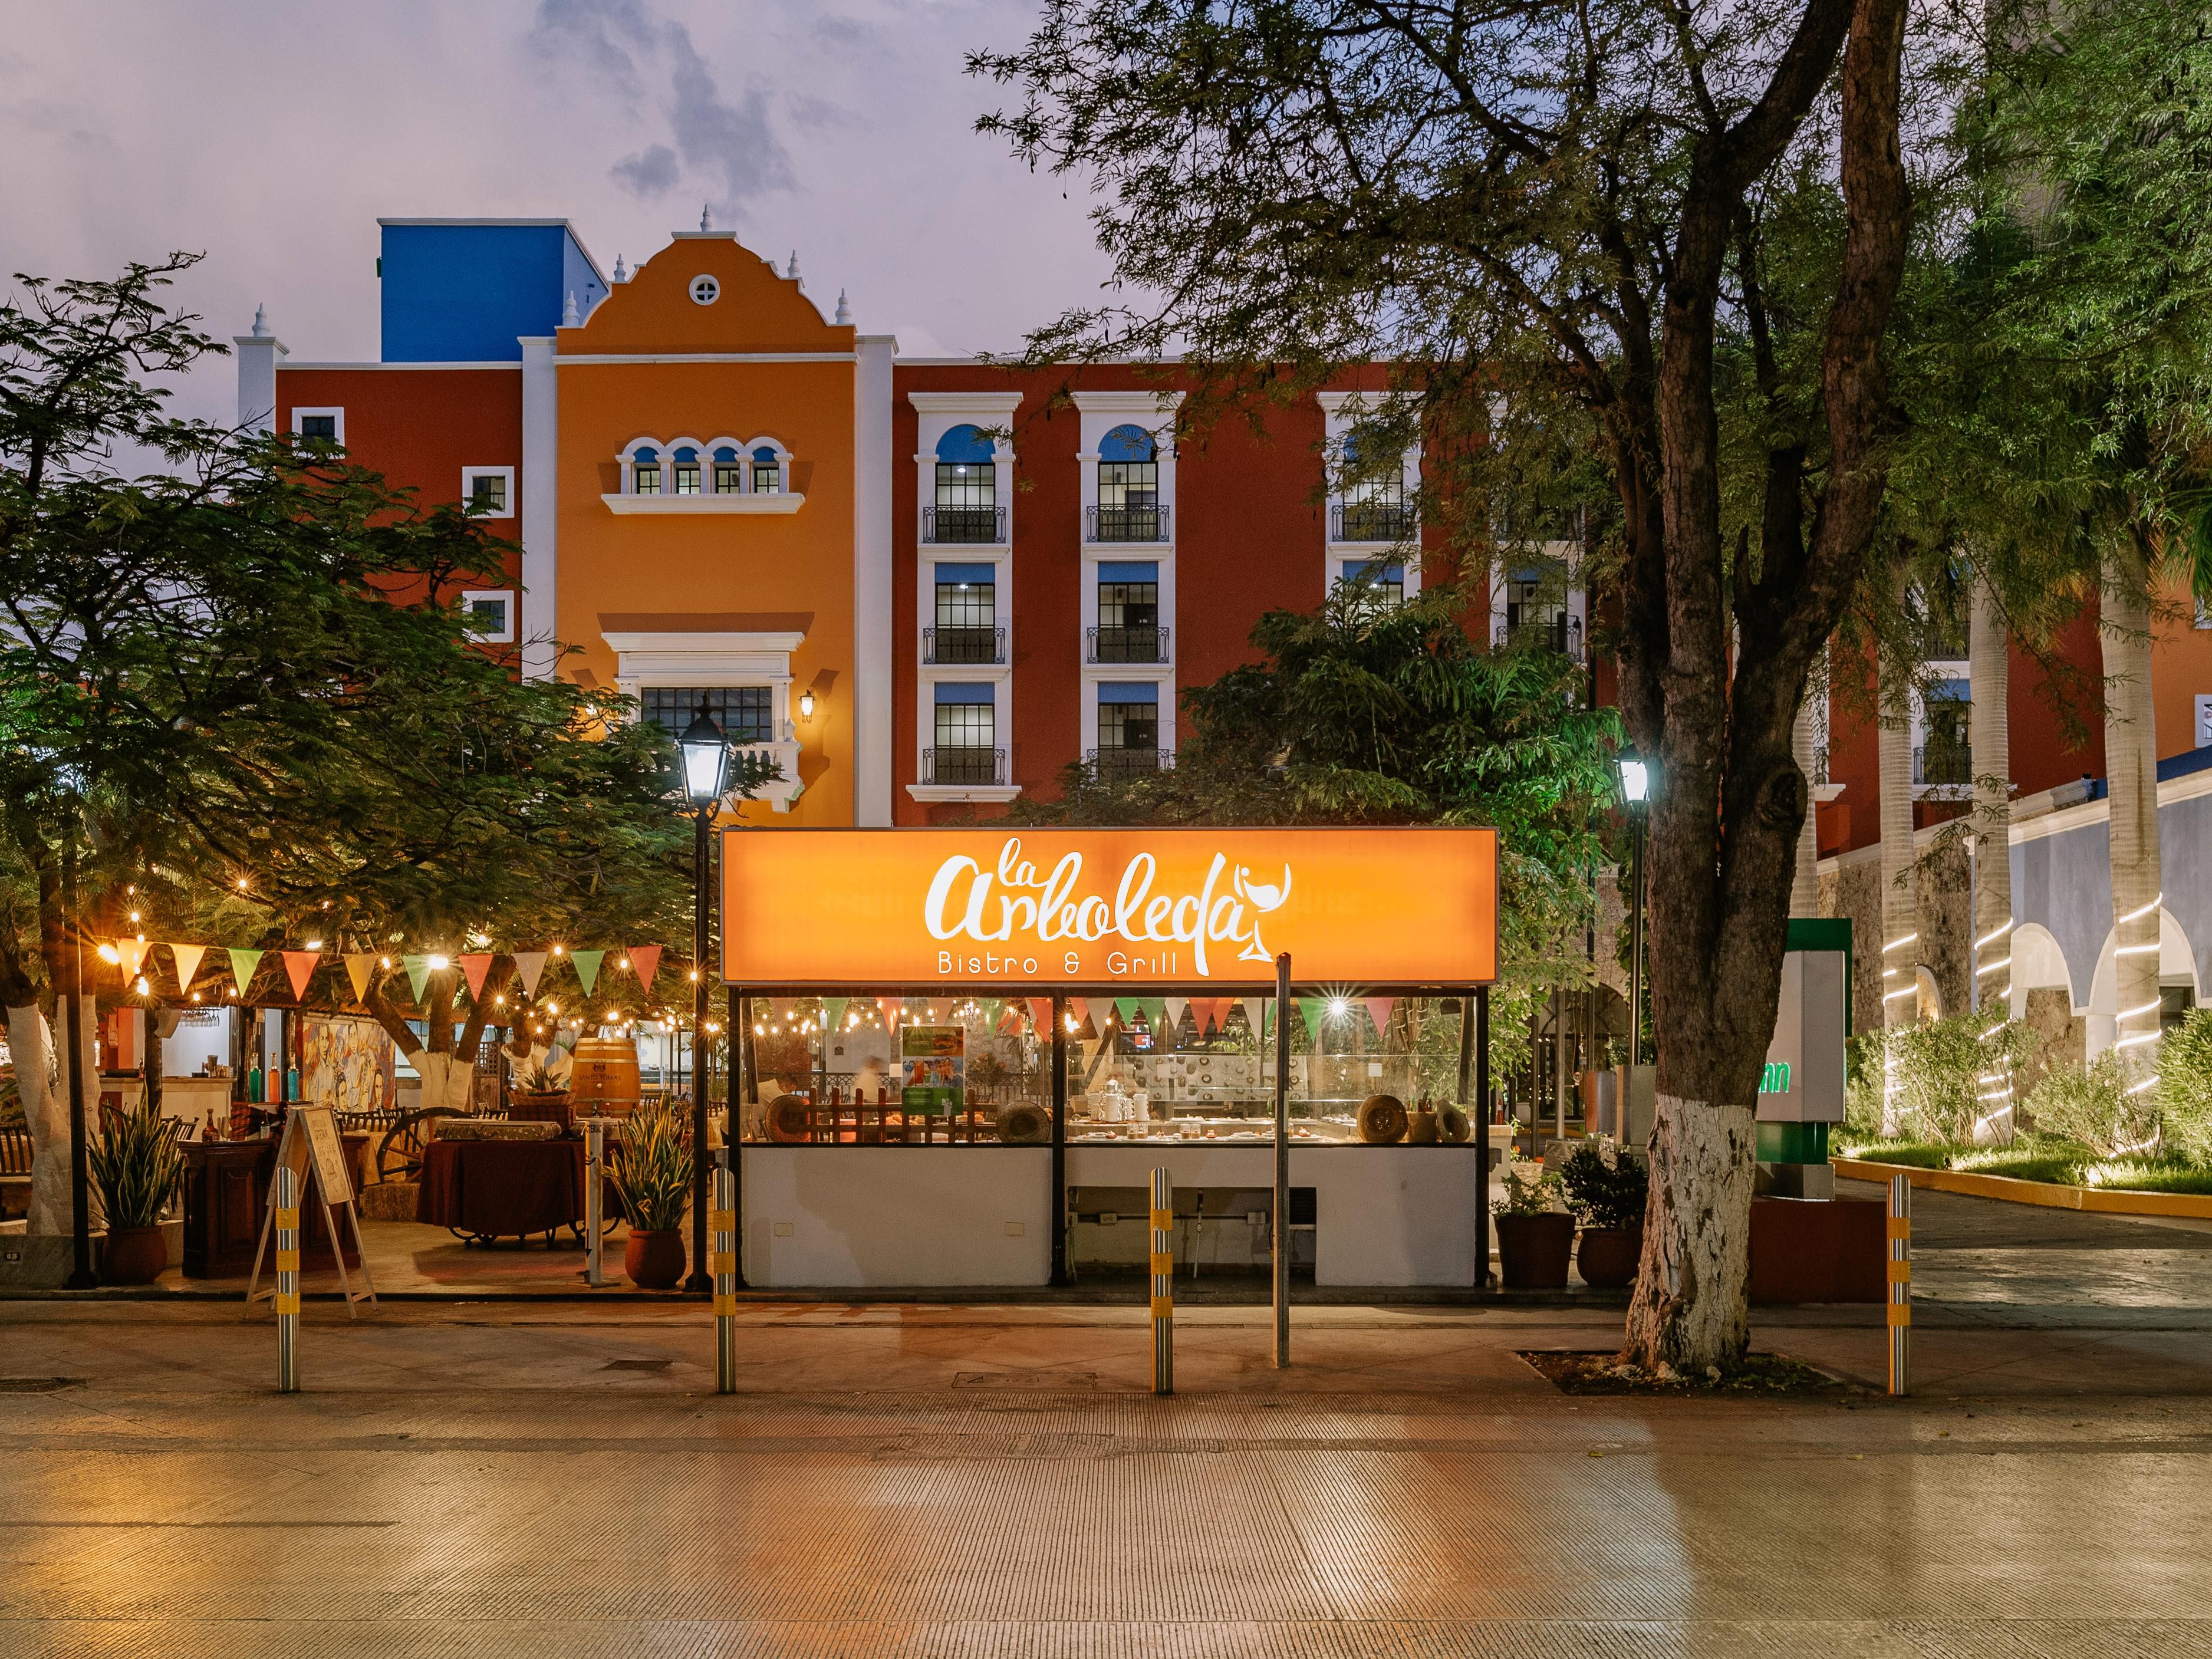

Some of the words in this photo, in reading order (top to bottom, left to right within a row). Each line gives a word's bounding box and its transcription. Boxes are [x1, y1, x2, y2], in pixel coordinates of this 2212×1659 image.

[998, 837, 1040, 887] la
[938, 951, 1038, 974] Bistro
[1064, 951, 1080, 975] &
[1107, 951, 1177, 975] Grill
